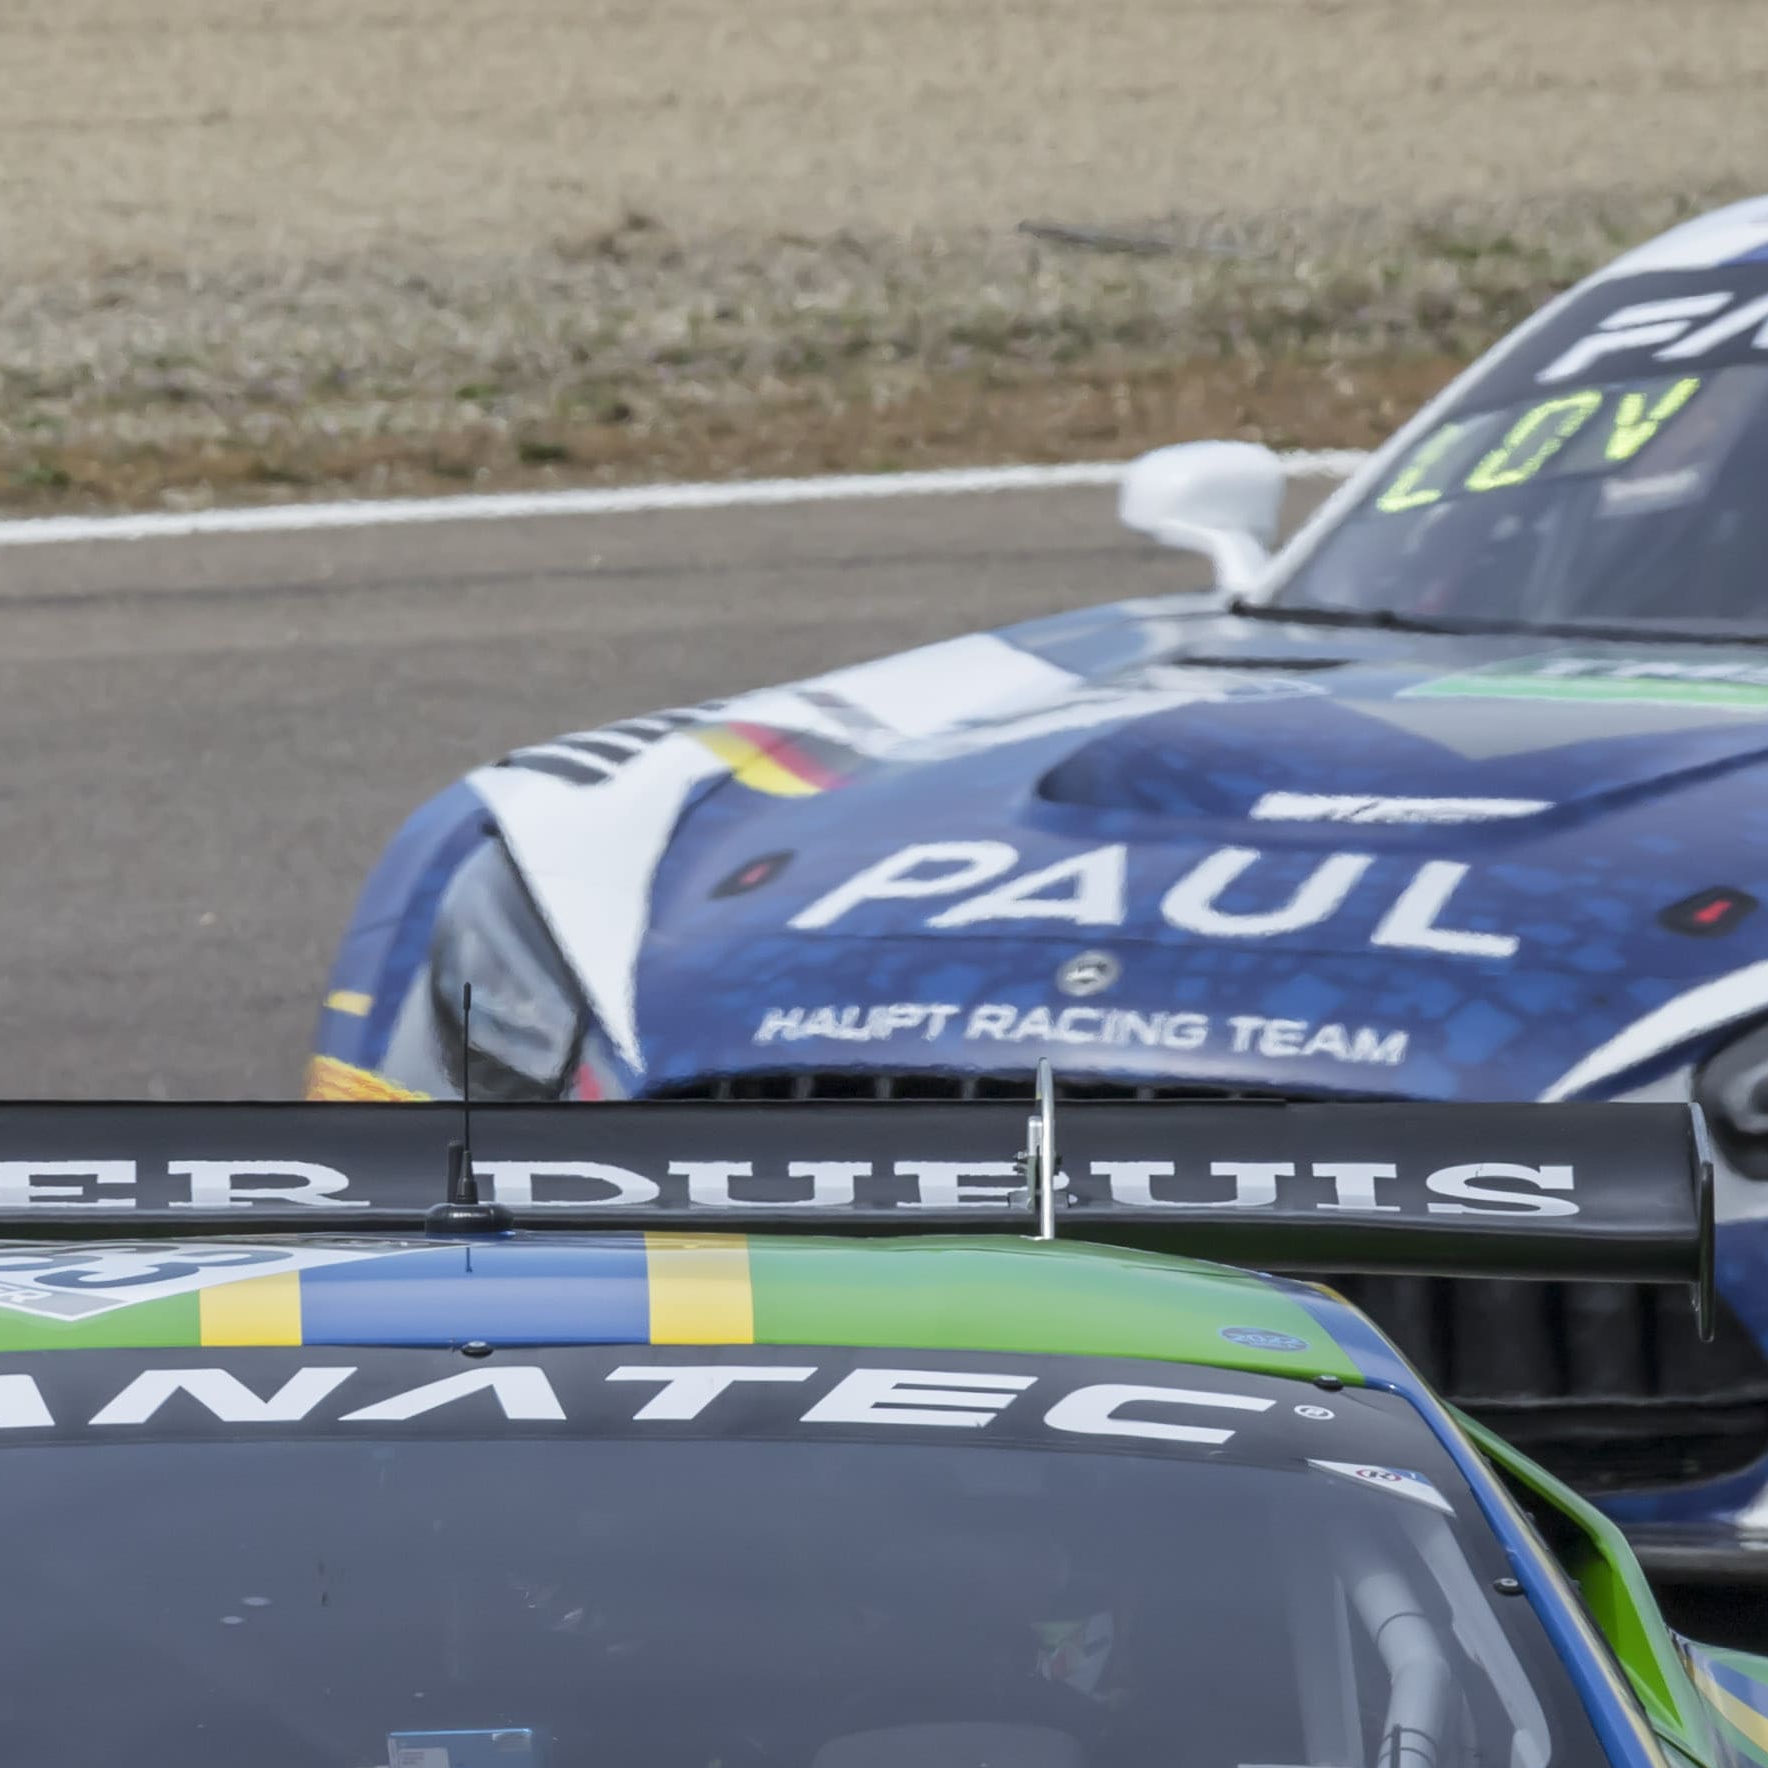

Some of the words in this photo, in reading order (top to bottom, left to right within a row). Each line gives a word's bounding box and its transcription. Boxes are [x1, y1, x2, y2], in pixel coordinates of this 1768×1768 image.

[1376, 376, 1701, 514] LOV
[785, 837, 1520, 958] PAUL
[752, 1002, 961, 1044] HAUPT
[965, 1003, 1211, 1050] RACING
[1227, 1014, 1409, 1067] TEAM
